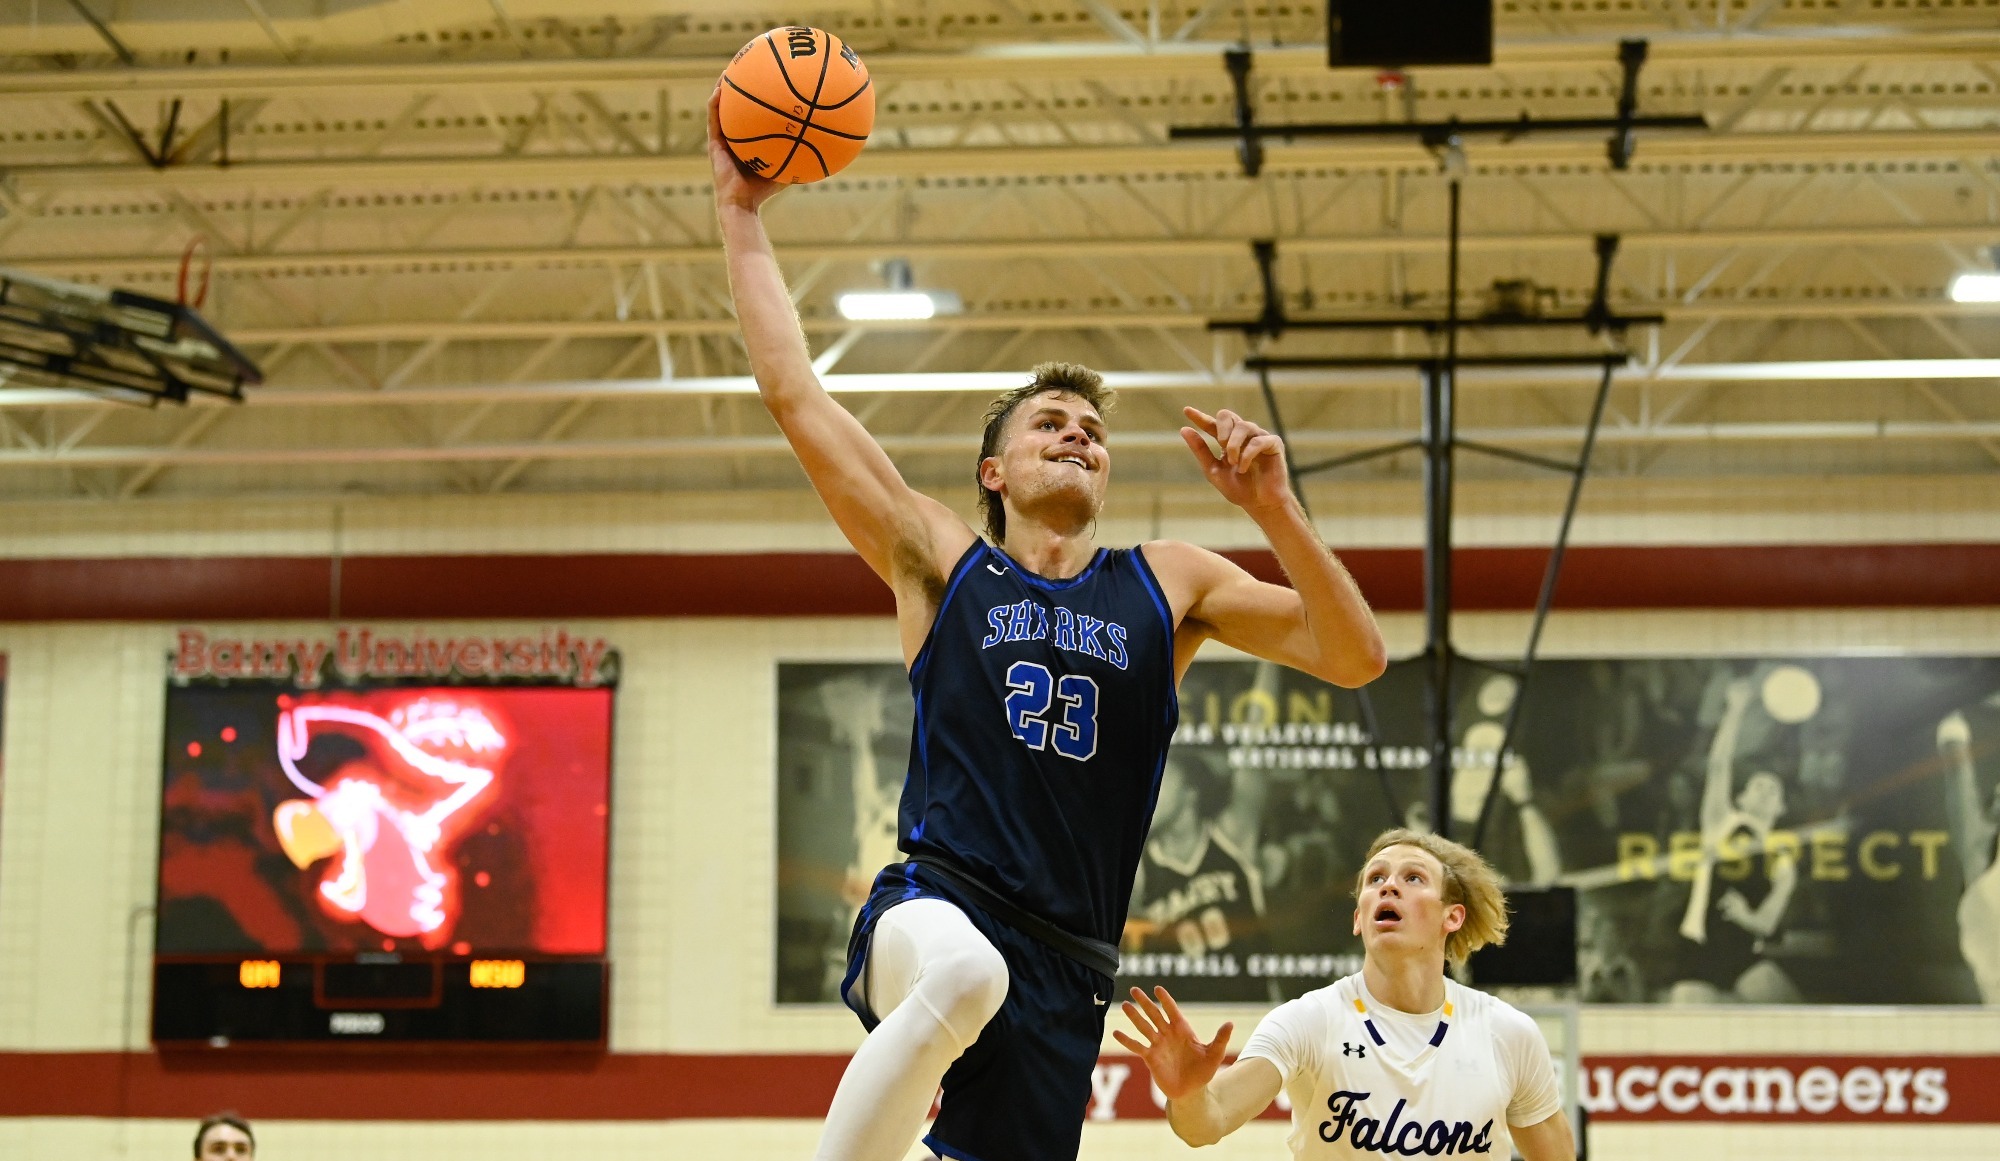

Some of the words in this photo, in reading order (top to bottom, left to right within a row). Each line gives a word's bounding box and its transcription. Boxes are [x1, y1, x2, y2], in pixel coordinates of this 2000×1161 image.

[175, 627, 327, 686] Barry
[333, 627, 606, 687] University
[982, 599, 1128, 670] SHARKS
[1005, 661, 1099, 762] 23
[1616, 829, 1948, 881] RESPECT
[1578, 1064, 1949, 1114] uccaneers
